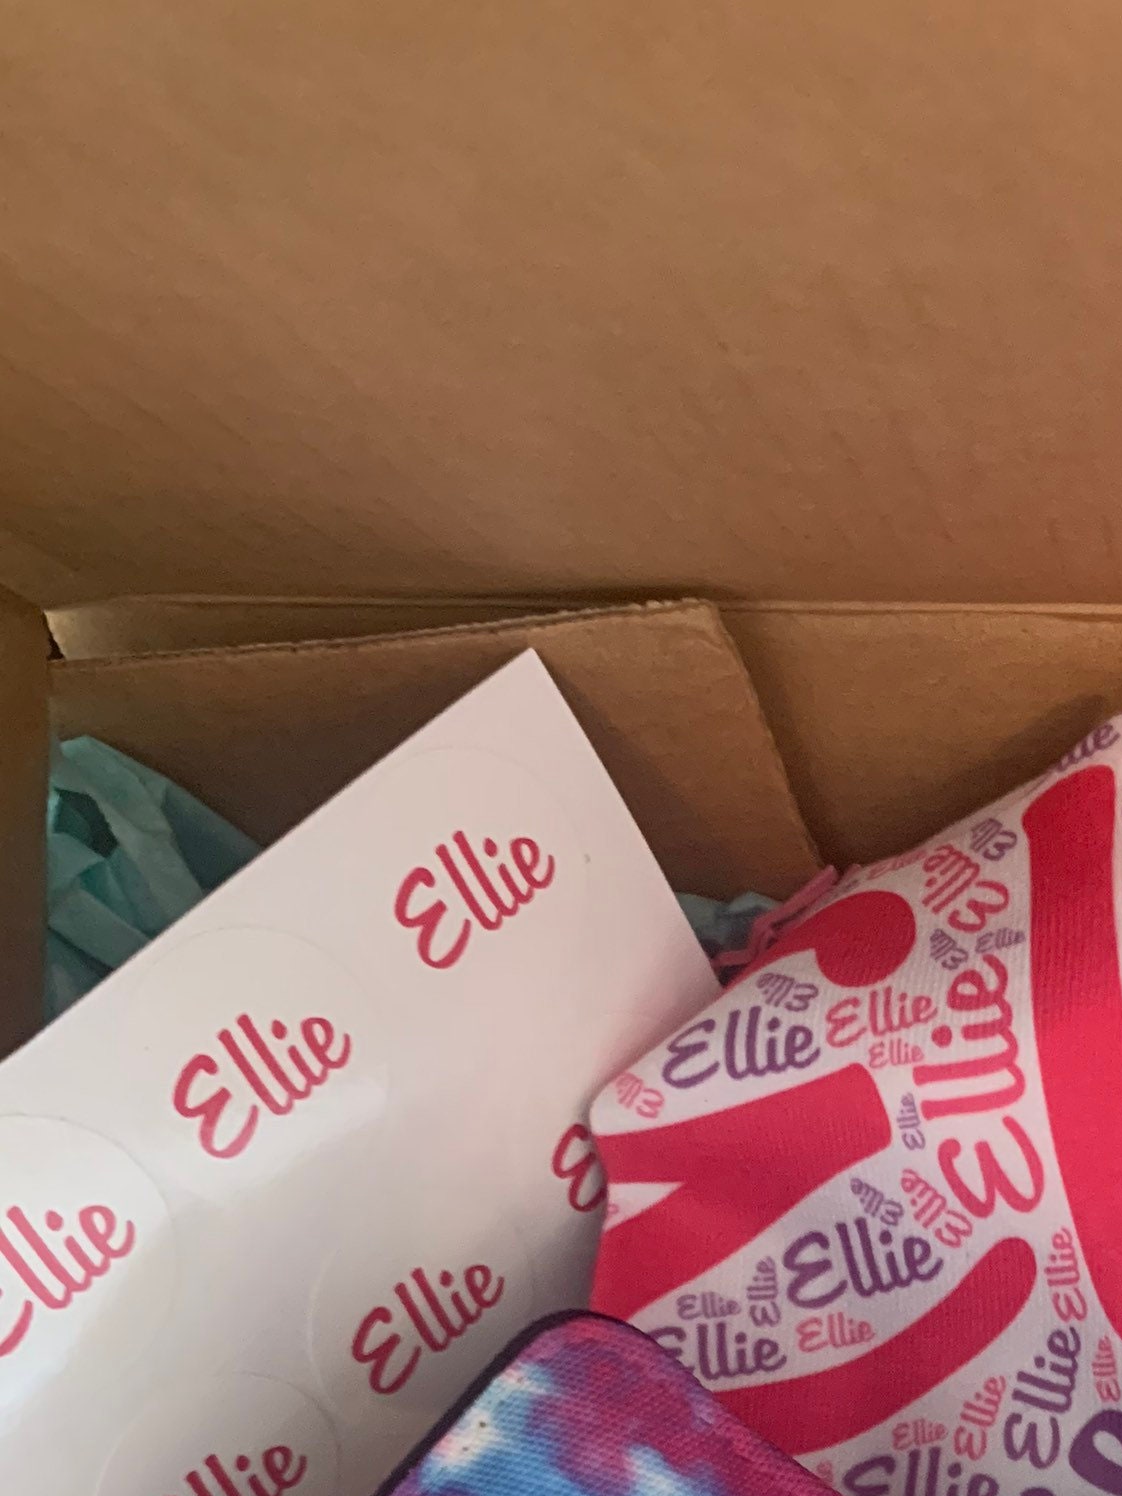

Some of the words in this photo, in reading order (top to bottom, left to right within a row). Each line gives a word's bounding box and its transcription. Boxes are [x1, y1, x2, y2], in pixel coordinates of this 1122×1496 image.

[394, 831, 555, 969] Ellie
[922, 844, 1010, 933] Ellie
[662, 1006, 820, 1089] Ellie
[825, 987, 938, 1048] Ellie
[868, 1038, 924, 1069] Ellie
[172, 1014, 351, 1159] Ellie
[913, 954, 1044, 1219] Ellie
[901, 1169, 973, 1248] Ellie
[0, 1204, 136, 1357] llie
[677, 1291, 741, 1320] Ellie
[747, 1256, 781, 1328] Ellie
[783, 1216, 943, 1309] Ellie
[1044, 1227, 1088, 1323] Ellie
[351, 1263, 504, 1395] Ellie
[796, 1312, 874, 1353] Ellie
[892, 1418, 947, 1451] Ellie
[954, 1375, 1007, 1461] Ellie
[1003, 1326, 1081, 1469] Ellie
